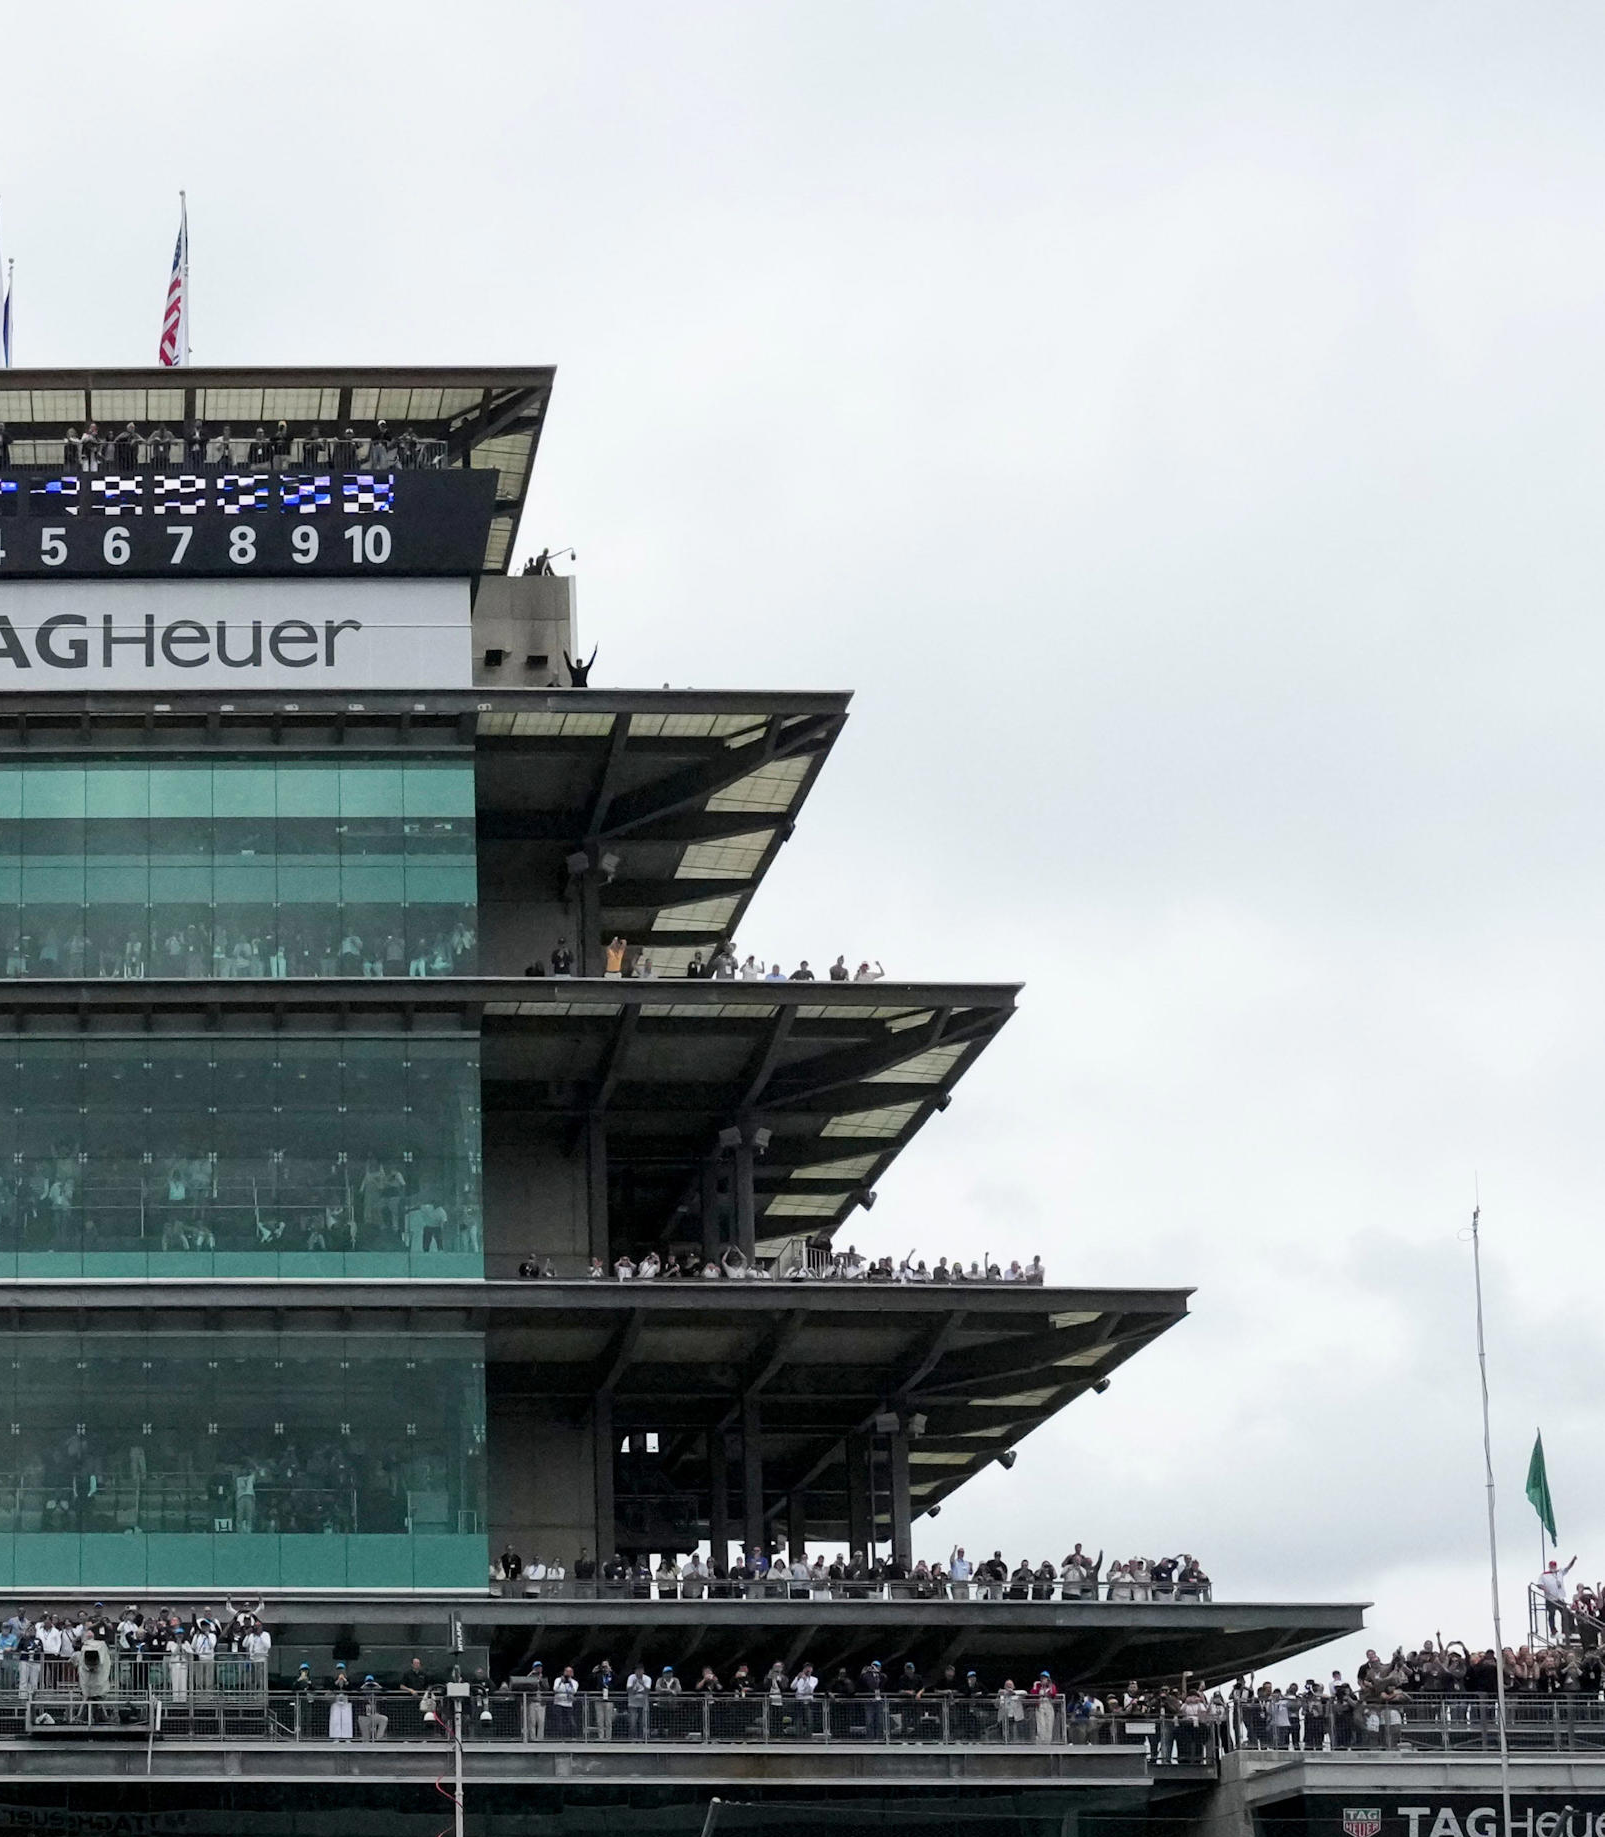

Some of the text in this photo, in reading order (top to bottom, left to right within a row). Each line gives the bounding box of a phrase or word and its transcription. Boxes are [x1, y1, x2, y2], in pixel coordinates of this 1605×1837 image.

[41, 527, 68, 566] 5
[103, 526, 131, 566] 6
[166, 526, 193, 564] 7
[229, 525, 257, 565] 8
[291, 525, 319, 564] 9
[344, 524, 392, 564] 10
[1346, 1808, 1379, 1820] TAG
